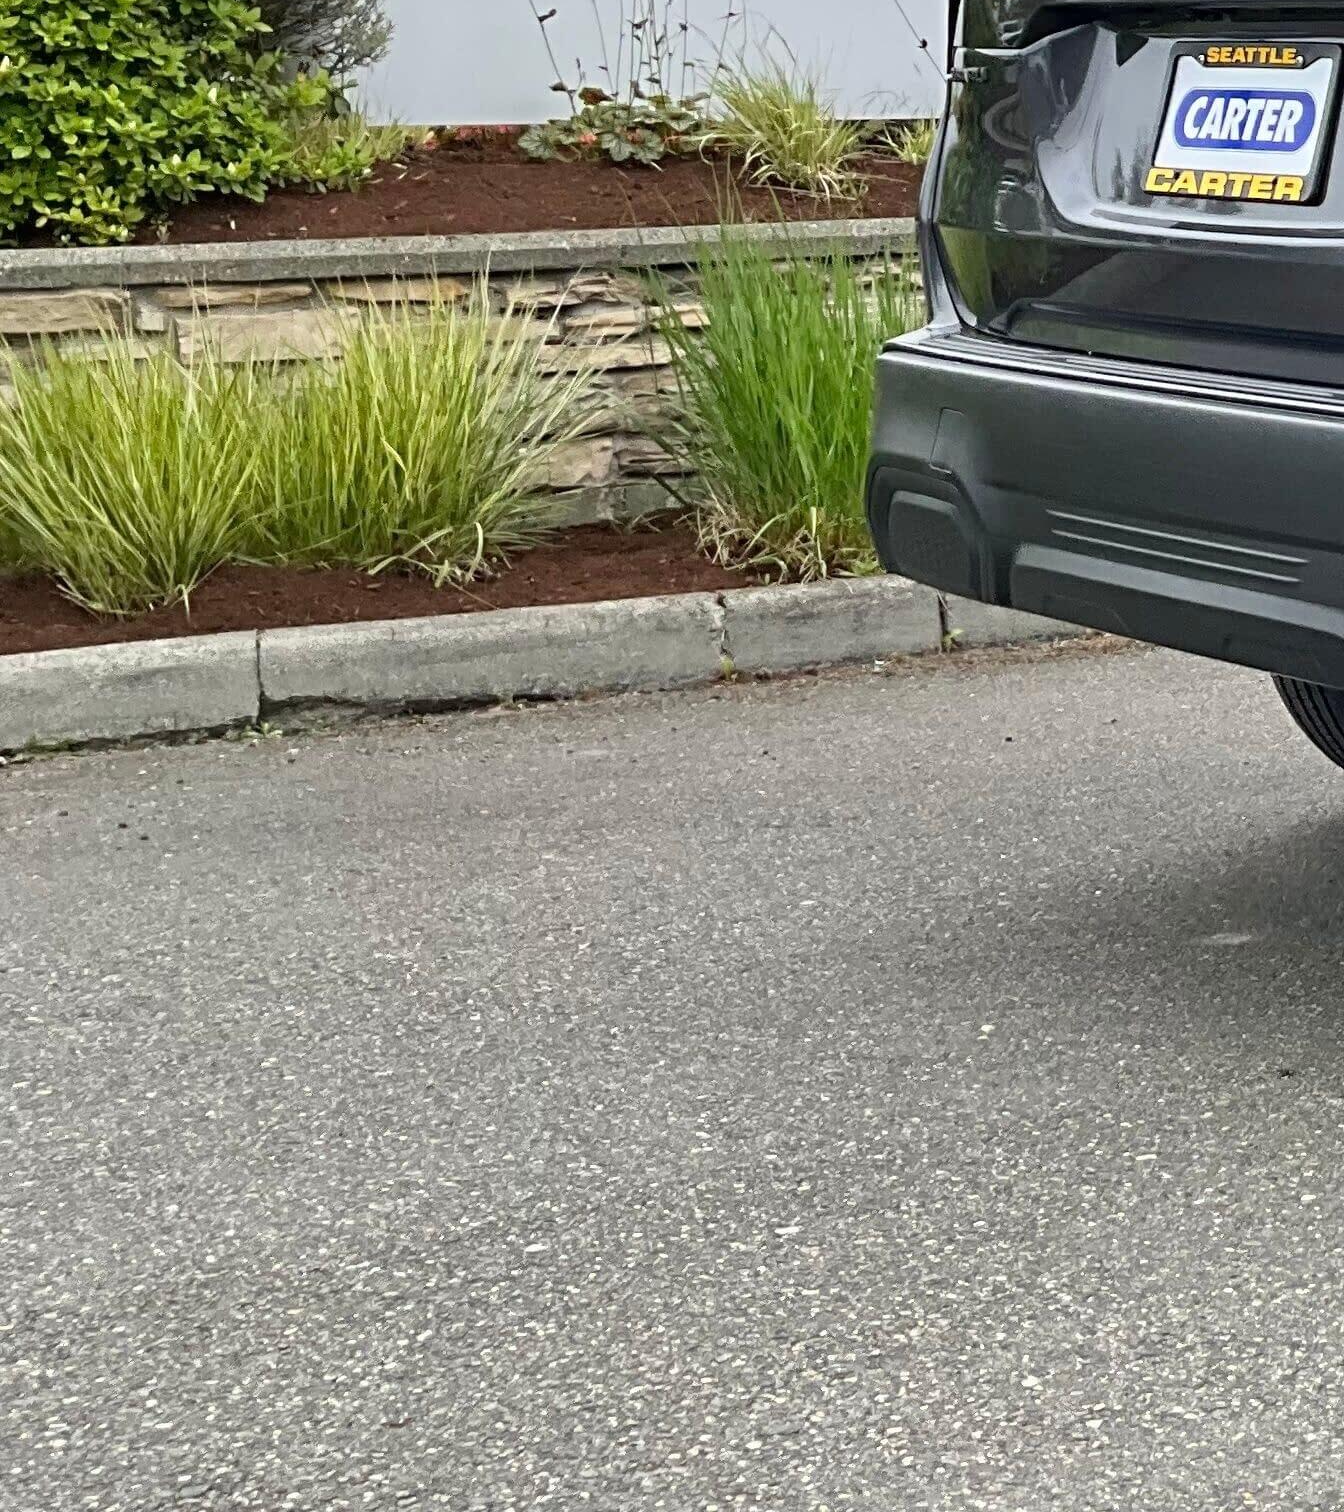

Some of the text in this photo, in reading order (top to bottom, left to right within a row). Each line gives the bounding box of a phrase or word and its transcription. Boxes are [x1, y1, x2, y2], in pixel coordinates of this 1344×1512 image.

[1207, 46, 1298, 65] SEATTLE
[1183, 96, 1303, 143] CARTER
[1144, 168, 1303, 201] CARTER
